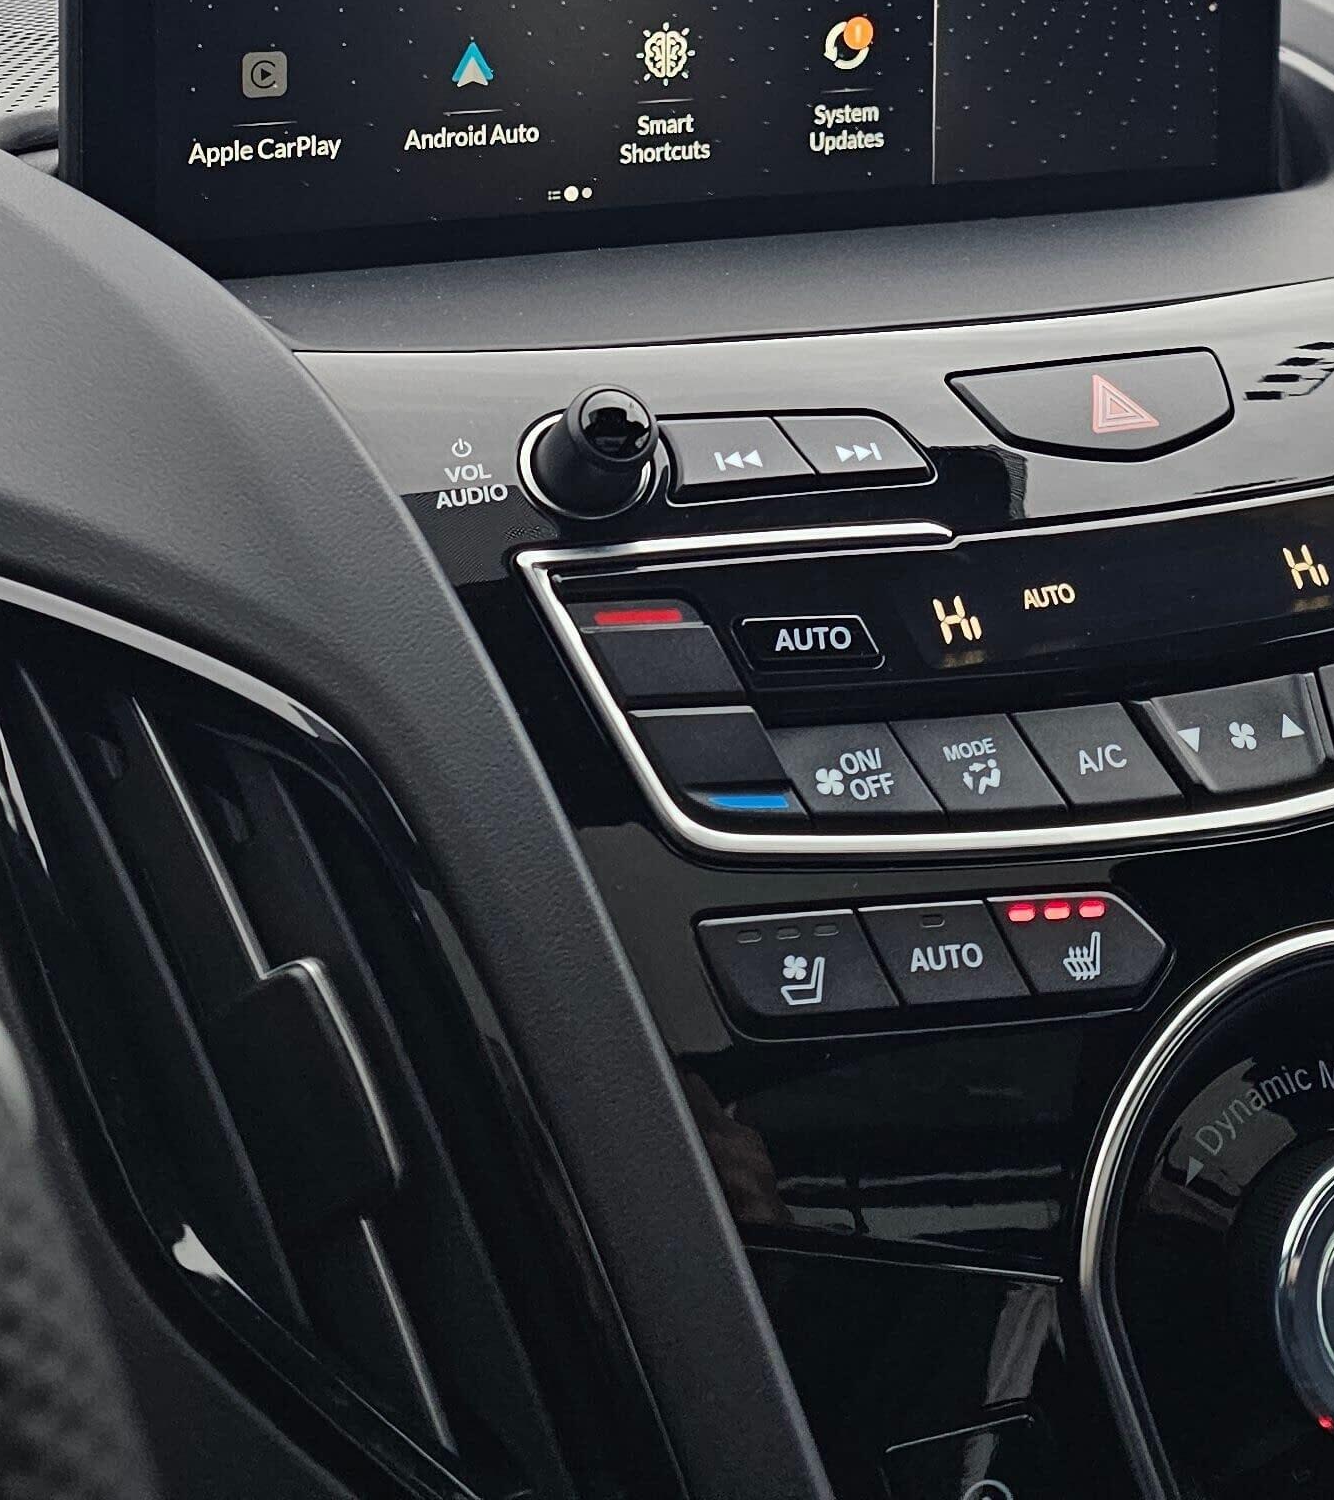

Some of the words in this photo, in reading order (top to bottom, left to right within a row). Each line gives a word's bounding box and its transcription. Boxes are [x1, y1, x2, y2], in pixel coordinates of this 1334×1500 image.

[637, 113, 695, 136] Smart
[813, 104, 880, 129] System
[403, 123, 487, 151] Android
[489, 121, 540, 146] Auto
[809, 129, 885, 156] Updates
[187, 139, 255, 168] Apple
[257, 134, 342, 163] CarPlay
[619, 140, 711, 165] Shortcuts
[444, 463, 492, 483] VOL
[436, 483, 509, 510] AUDIO
[1023, 582, 1076, 610] AUTO
[774, 626, 852, 652] AUTO
[839, 747, 883, 771] ON/
[942, 737, 997, 762] MODE
[1078, 743, 1128, 775] A/C
[849, 772, 895, 801] OFF
[910, 942, 984, 973] AUTO
[1194, 1065, 1312, 1157] Dynamic
